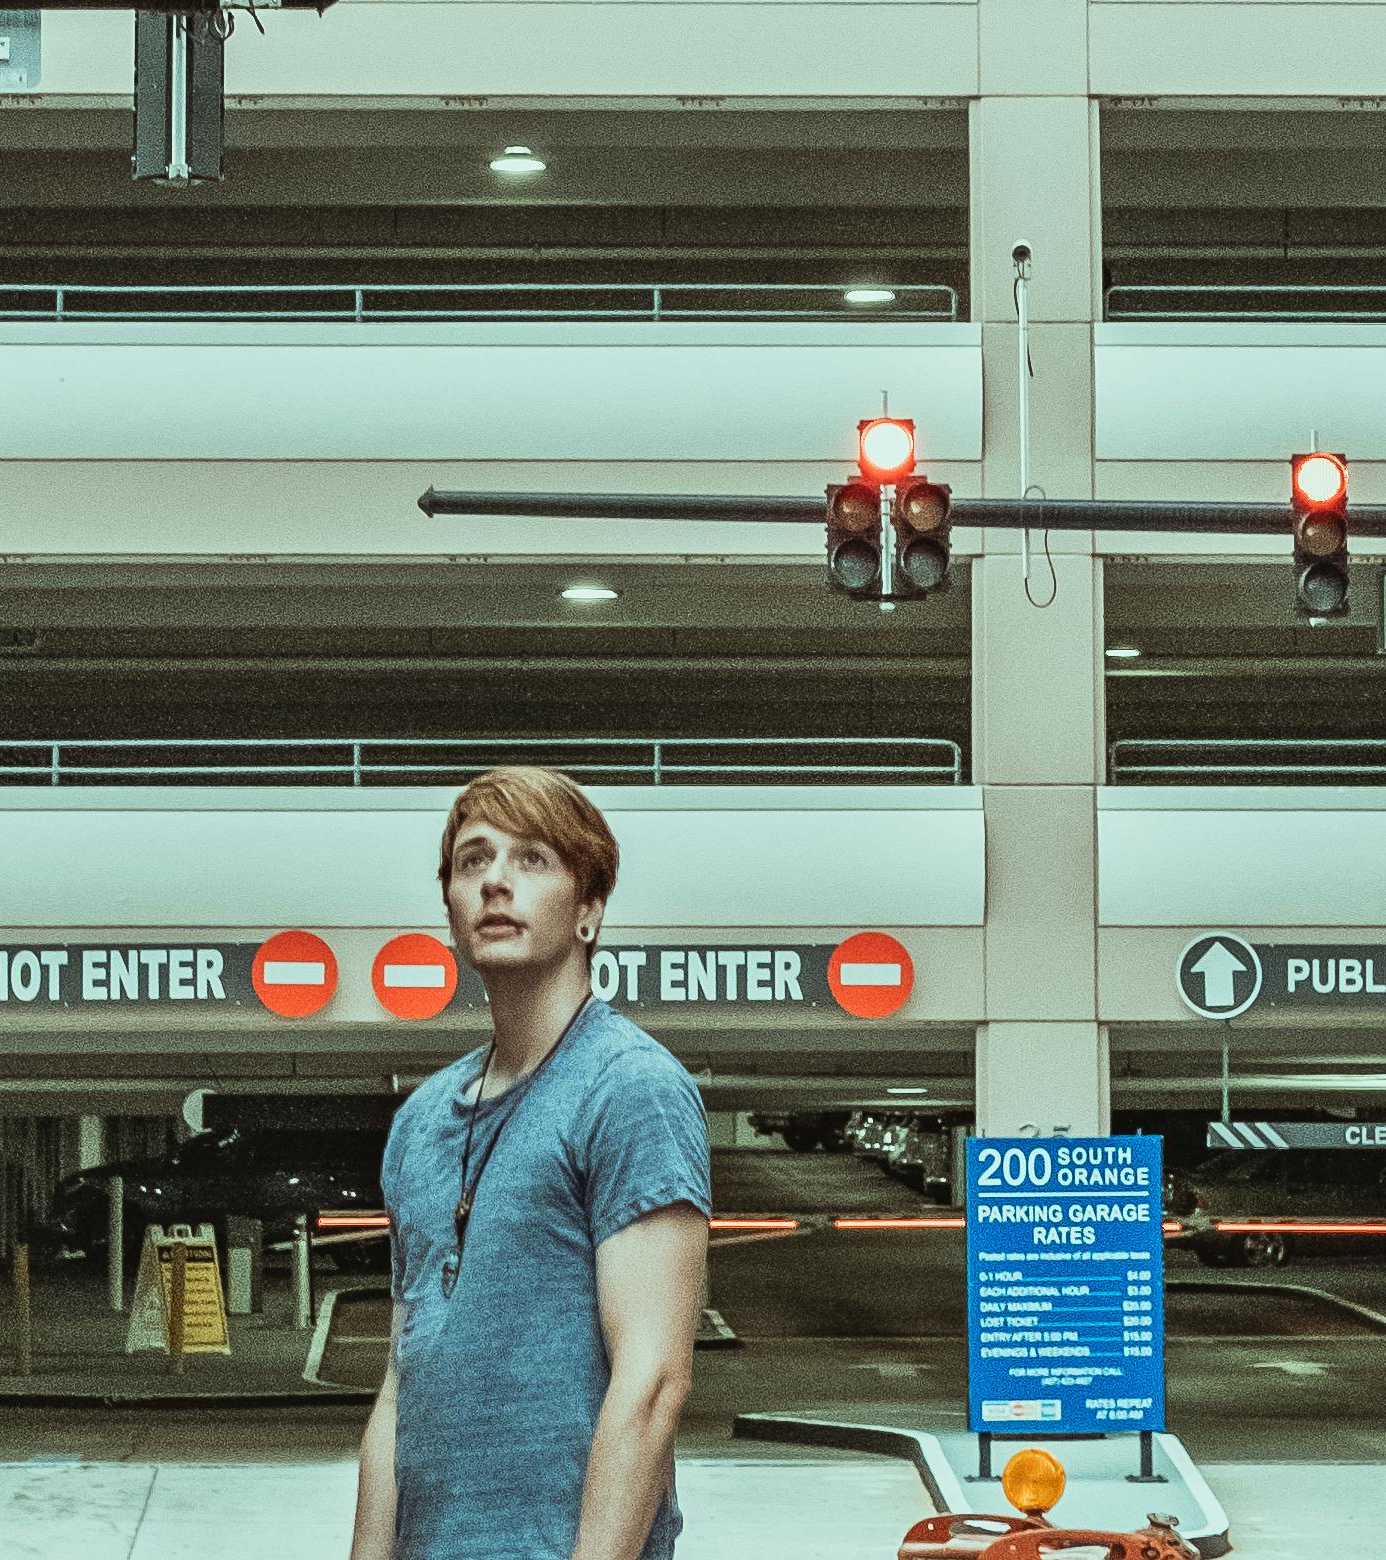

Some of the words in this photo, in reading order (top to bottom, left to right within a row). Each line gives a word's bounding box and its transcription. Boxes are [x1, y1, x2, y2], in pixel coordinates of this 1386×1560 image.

[82, 949, 226, 1001] ENTER
[591, 950, 647, 1002] OT
[661, 950, 804, 1001] ENTER
[977, 1147, 1052, 1186] 200
[1057, 1147, 1132, 1165] SOUTH
[1057, 1167, 1150, 1186] ORANGE
[977, 1205, 1063, 1223] PARKING
[1068, 1204, 1151, 1222] GARAGE
[1033, 1226, 1096, 1245] RATES
